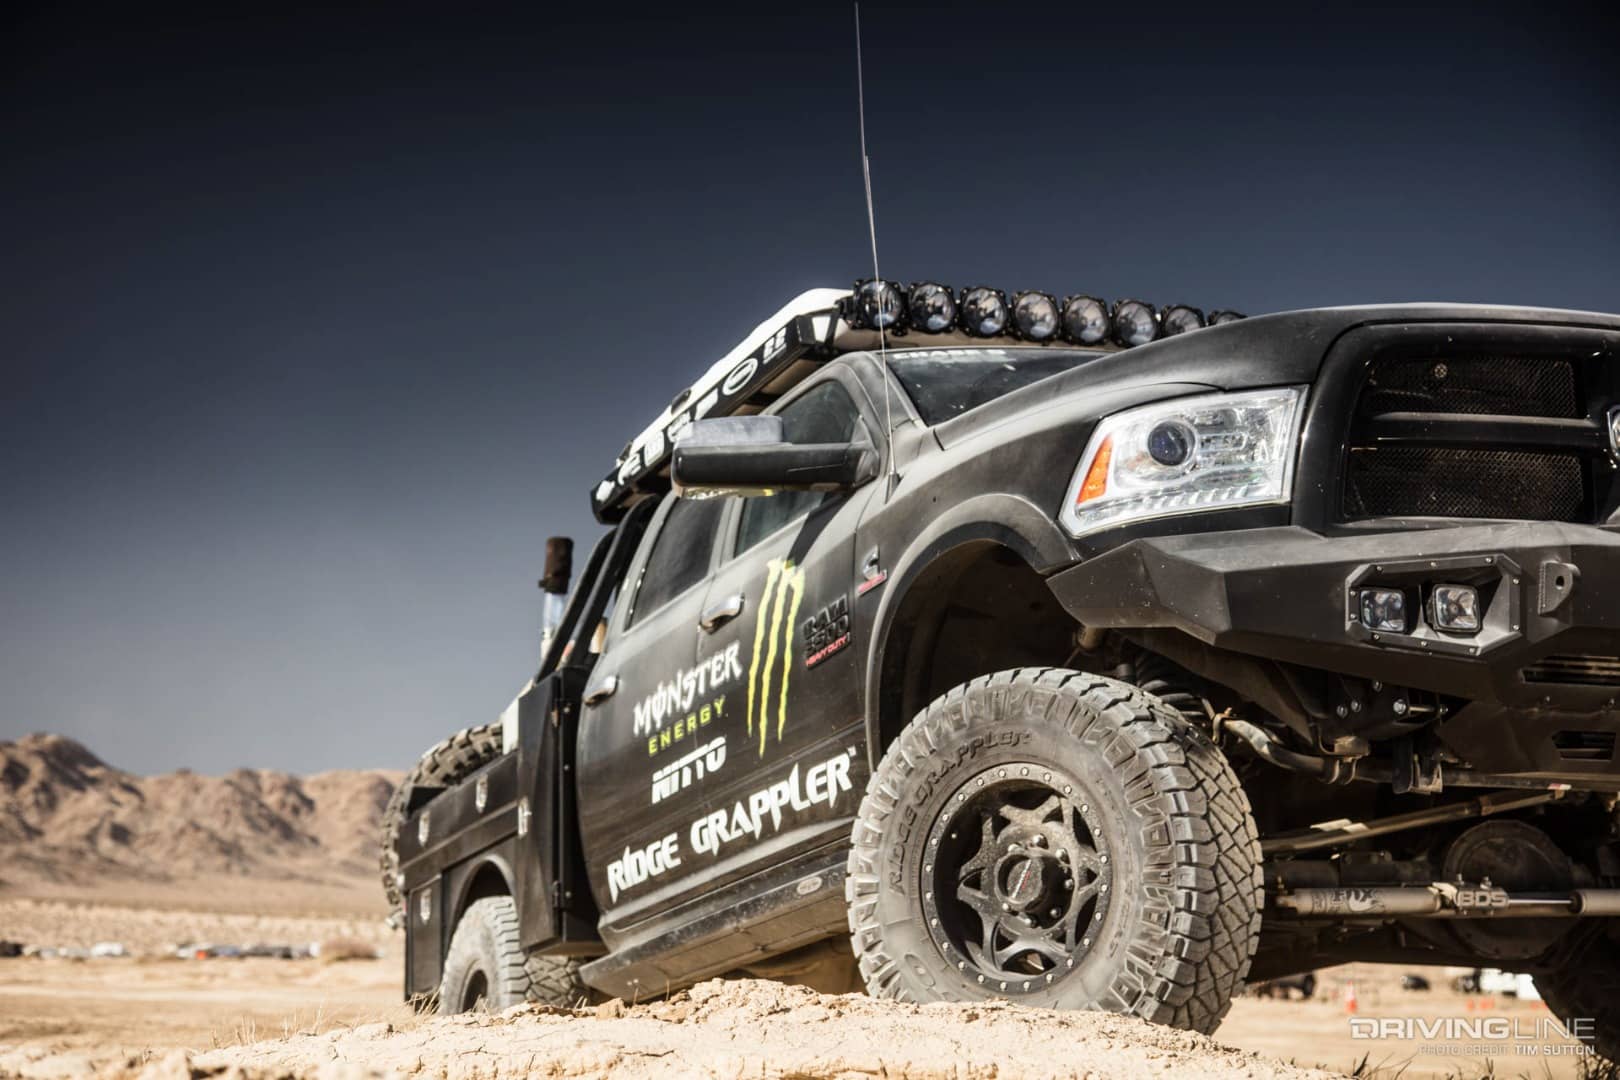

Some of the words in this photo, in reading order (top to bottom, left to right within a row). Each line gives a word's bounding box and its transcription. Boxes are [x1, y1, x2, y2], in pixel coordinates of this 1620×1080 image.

[633, 640, 743, 737] MONSTER
[648, 695, 726, 757] ENERGY
[652, 736, 727, 804] NITTO
[607, 832, 682, 904] RIDGE
[690, 752, 852, 857] GRAPPLER
[1459, 891, 1508, 907] BDS
